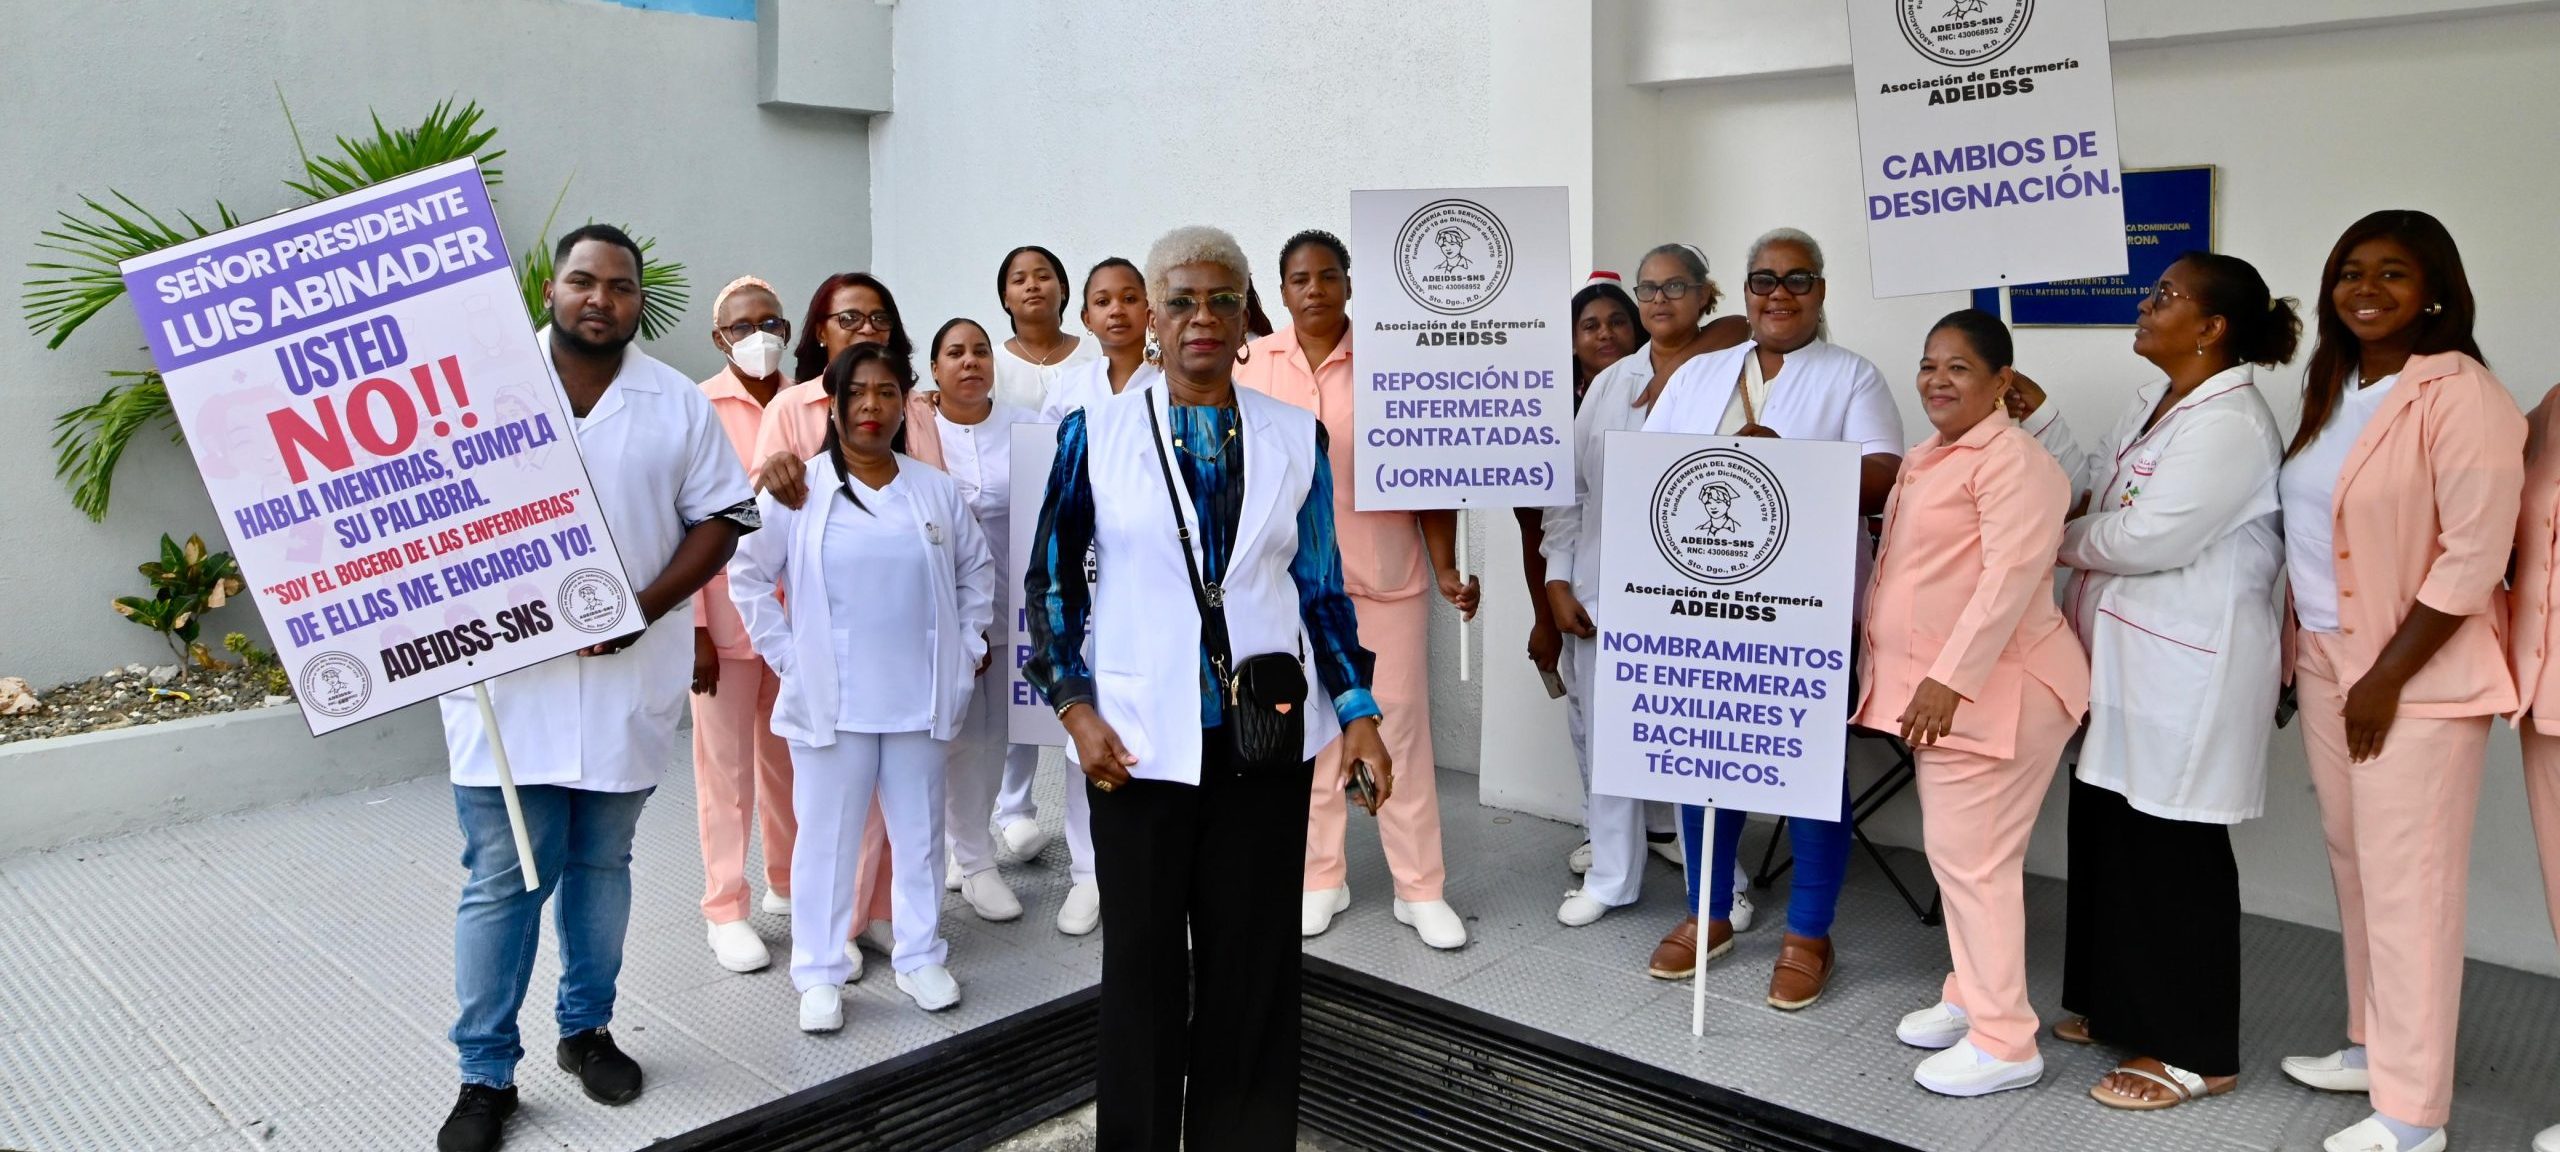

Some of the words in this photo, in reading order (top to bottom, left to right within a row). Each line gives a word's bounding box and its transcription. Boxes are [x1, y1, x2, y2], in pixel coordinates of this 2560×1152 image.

[1930, 16, 2004, 34] ADEIDSS-SNS
[1937, 33, 1956, 42] RNC:
[1957, 27, 1999, 39] 430068952
[1939, 47, 1956, 56] Sto.
[1880, 74, 1963, 95] Asociación
[1967, 70, 1986, 83] de
[1990, 58, 2079, 80] Enfermería
[1928, 77, 2035, 106] ADEIDSS
[1882, 137, 2046, 180] CAMBIOS
[2053, 131, 2098, 161] DE
[1869, 164, 2120, 221] DESIGNACIÓN.
[1449, 217, 1481, 232] Diciembre
[1458, 209, 1488, 227] SERVICIO
[1486, 225, 1503, 258] NACIONAL
[2137, 222, 2191, 232] DOMINICANA
[156, 255, 275, 304] SEÑOR
[273, 186, 469, 271] PRESIDENTE
[2127, 235, 2160, 246] RONA
[1422, 274, 1486, 283] ADEIDSS-SNS
[1428, 283, 1444, 291] RNC:
[2091, 286, 2137, 296] EVANGELINA
[2110, 277, 2125, 286] DEL
[161, 297, 264, 358] LUIS
[270, 226, 495, 328] ABINADER
[1429, 294, 1444, 304] Sto.
[1375, 320, 1447, 331] Asociación
[1451, 321, 1467, 331] de
[1470, 318, 1546, 330] Enfermería
[1416, 331, 1508, 347] ADEIDSS
[274, 314, 408, 396] USTED
[1372, 364, 1518, 391] REPOSICIÓN
[1524, 370, 1554, 390] DE
[266, 355, 478, 485] NO!!
[1386, 398, 1542, 419] ENFERMERAS
[1367, 426, 1561, 447] CONTRATADAS.
[234, 488, 320, 540] HABLA
[318, 449, 453, 515] MENTIRAS,
[452, 412, 557, 470] CUMPLA
[1375, 461, 1554, 493] (JORNALERAS)
[1710, 460, 1725, 468] DEL
[1727, 461, 1762, 484] SERVICIO
[1663, 497, 1671, 508] DE
[1670, 486, 1687, 517] Fundada
[1687, 479, 1694, 487] el
[1695, 472, 1704, 481] 18
[1717, 469, 1754, 490] Diciembre
[1753, 489, 1764, 502] del
[1760, 483, 1777, 523] NACIONAL
[334, 515, 372, 549] SU
[368, 477, 490, 538] PALABRA.
[1680, 536, 1755, 549] ADEIDSS-SNS
[1768, 525, 1777, 537] DE
[312, 570, 336, 593] EL
[335, 547, 404, 587] BOCERO
[403, 538, 429, 563] DE
[428, 528, 464, 556] LAS
[1686, 546, 1706, 556] RNC:
[1707, 548, 1749, 558] 430068952
[1687, 559, 1703, 571] Sto.
[1731, 562, 1749, 573] R.D.
[285, 613, 326, 649] DE
[321, 589, 399, 637] ELLAS
[397, 572, 444, 611] ME
[440, 538, 553, 600] ENCARGO
[550, 523, 597, 562] YO!
[1624, 582, 1707, 599] Asociación
[1711, 589, 1730, 600] de
[1735, 591, 1823, 608] Enfermería
[1670, 599, 1777, 622] ADEIDSS
[379, 600, 555, 683] ADEIDSS-SNS
[1603, 631, 1843, 671] NOMBRAMIENTOS
[1616, 661, 1649, 684] DE
[1653, 665, 1827, 700] ENFERMERAS
[1631, 693, 1783, 726] AUXILIARES
[1789, 707, 1807, 728] Y
[1632, 722, 1803, 758] BACHILLERES
[1645, 749, 1786, 787] TÉCNICOS.
